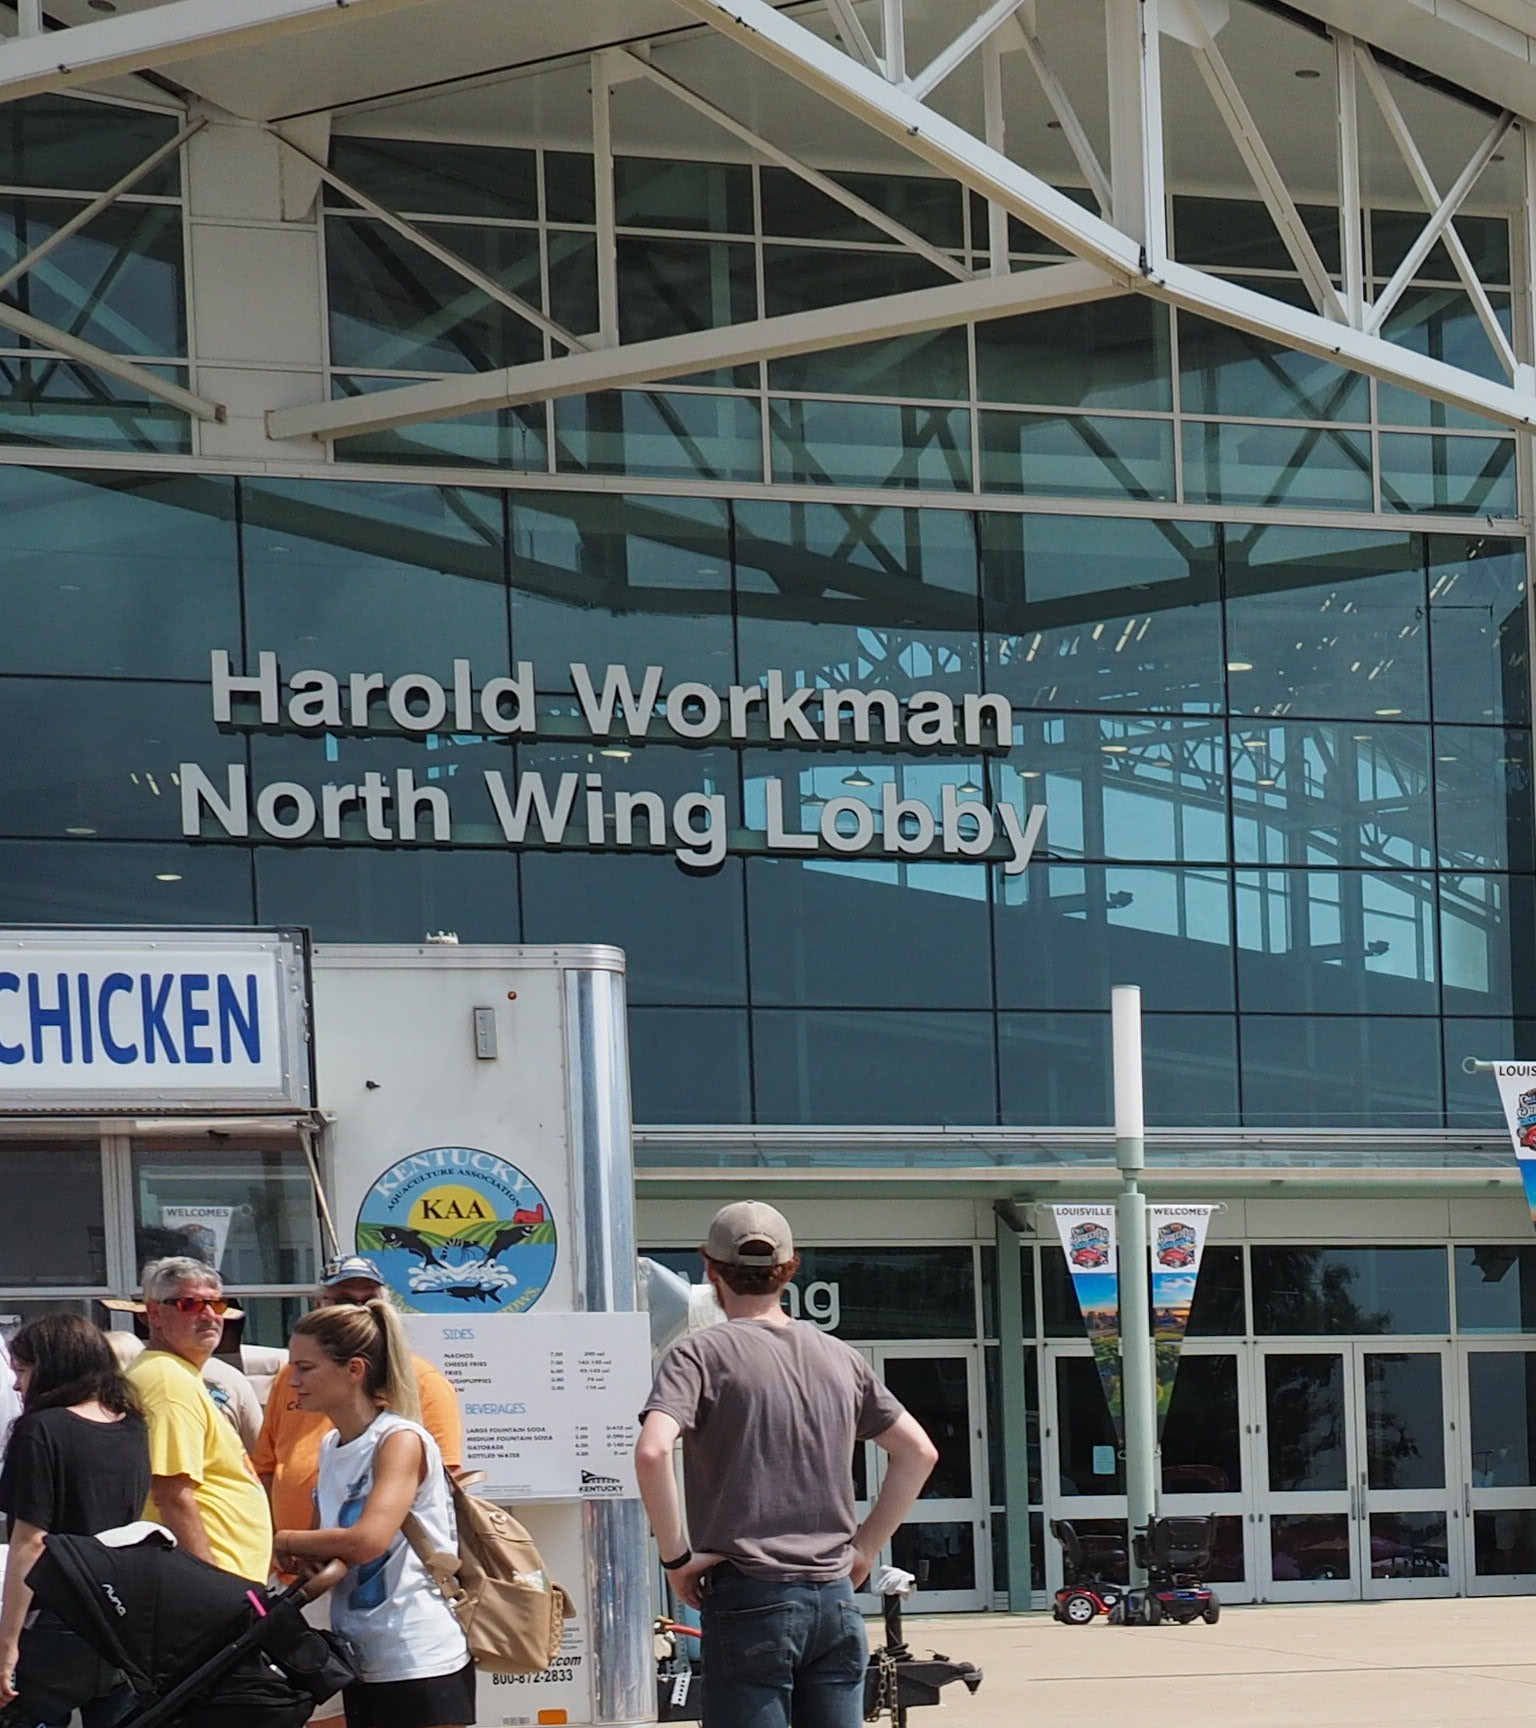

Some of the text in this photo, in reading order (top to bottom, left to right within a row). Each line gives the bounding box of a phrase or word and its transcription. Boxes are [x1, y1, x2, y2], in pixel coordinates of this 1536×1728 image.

[211, 650, 1012, 747] Harold Workman
[180, 762, 1047, 874] North Wing Lobby
[0, 972, 261, 1065] CHICKEN
[375, 1150, 532, 1197] KENTUCKY
[387, 1168, 521, 1212] AQUACULTURE ASSOCIATION
[166, 1208, 229, 1217] WELCOMES
[420, 1199, 486, 1220] KAA
[1056, 1207, 1209, 1216] LOUISVILLE WELCOMES
[443, 1328, 475, 1340] SIDES
[465, 1403, 527, 1414] BEVERAGES
